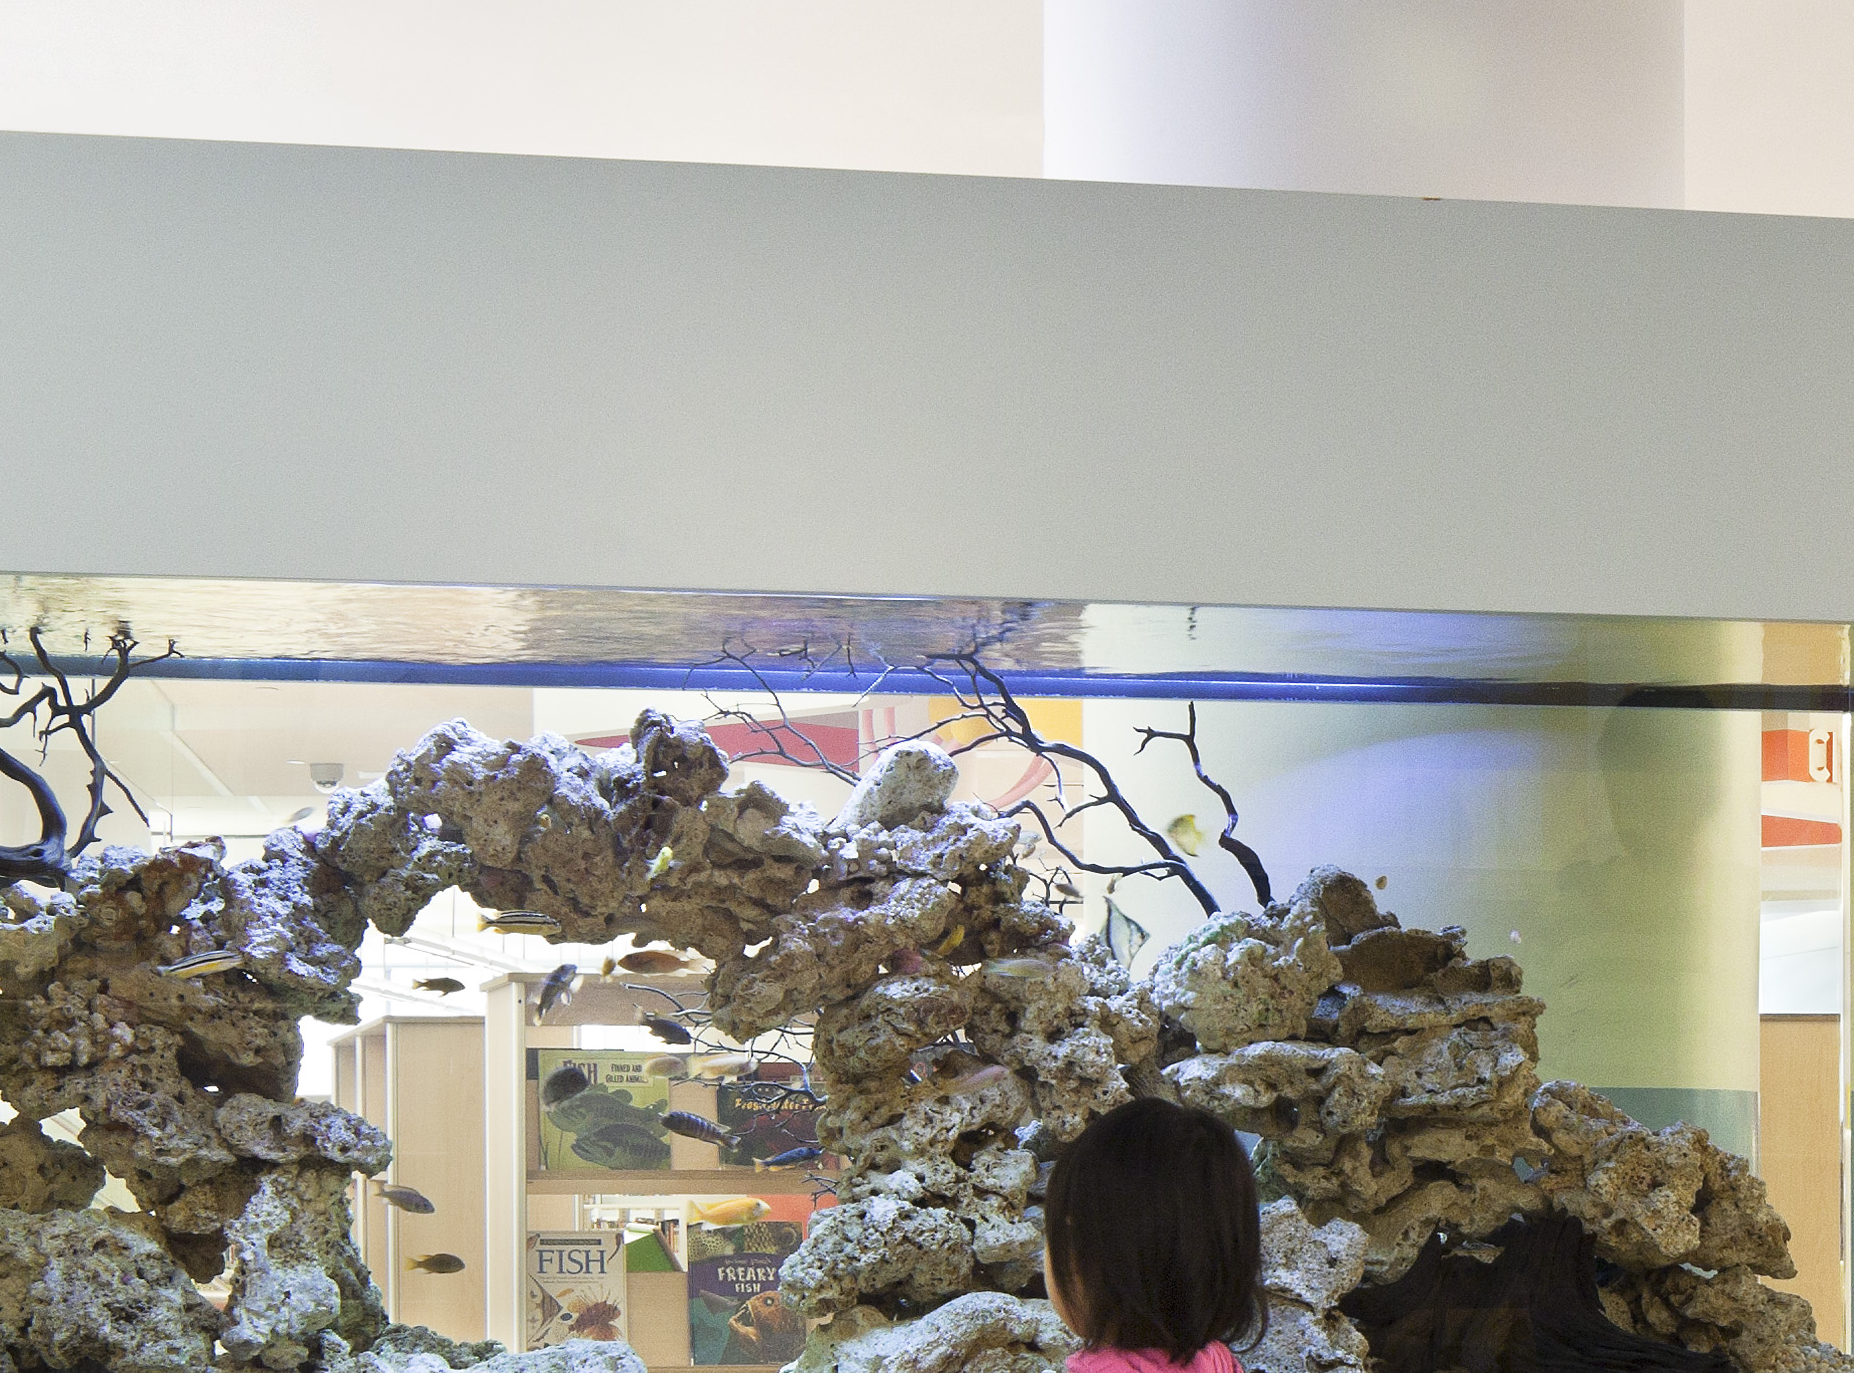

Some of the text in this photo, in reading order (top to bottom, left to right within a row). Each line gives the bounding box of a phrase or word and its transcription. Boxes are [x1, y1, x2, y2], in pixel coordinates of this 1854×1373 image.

[536, 1248, 607, 1275] FISH
[717, 1266, 776, 1282] FREAKY
[734, 1282, 761, 1293] FISH
